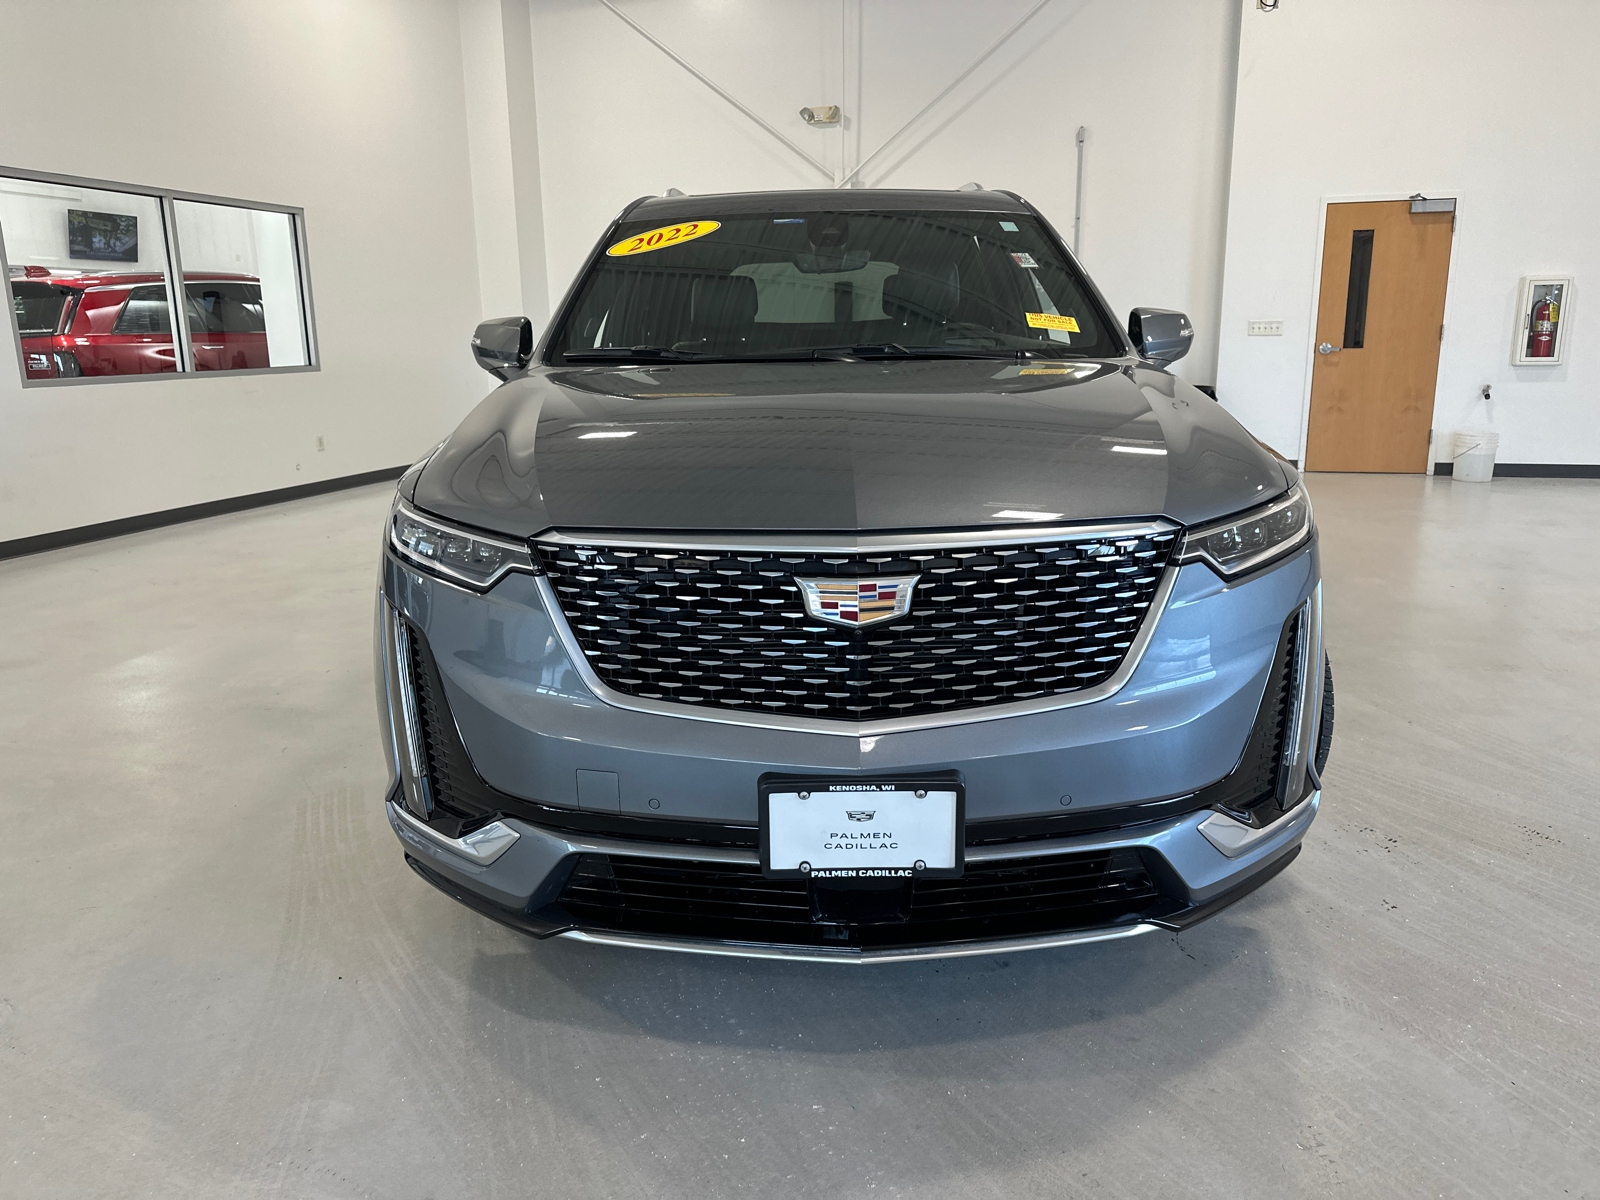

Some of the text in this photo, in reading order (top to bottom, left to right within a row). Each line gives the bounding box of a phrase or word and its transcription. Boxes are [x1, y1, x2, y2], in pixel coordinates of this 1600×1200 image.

[627, 223, 699, 253] 2022
[823, 842, 899, 850] CADILLAC
[811, 869, 913, 878] PALMEN CADILLAC
